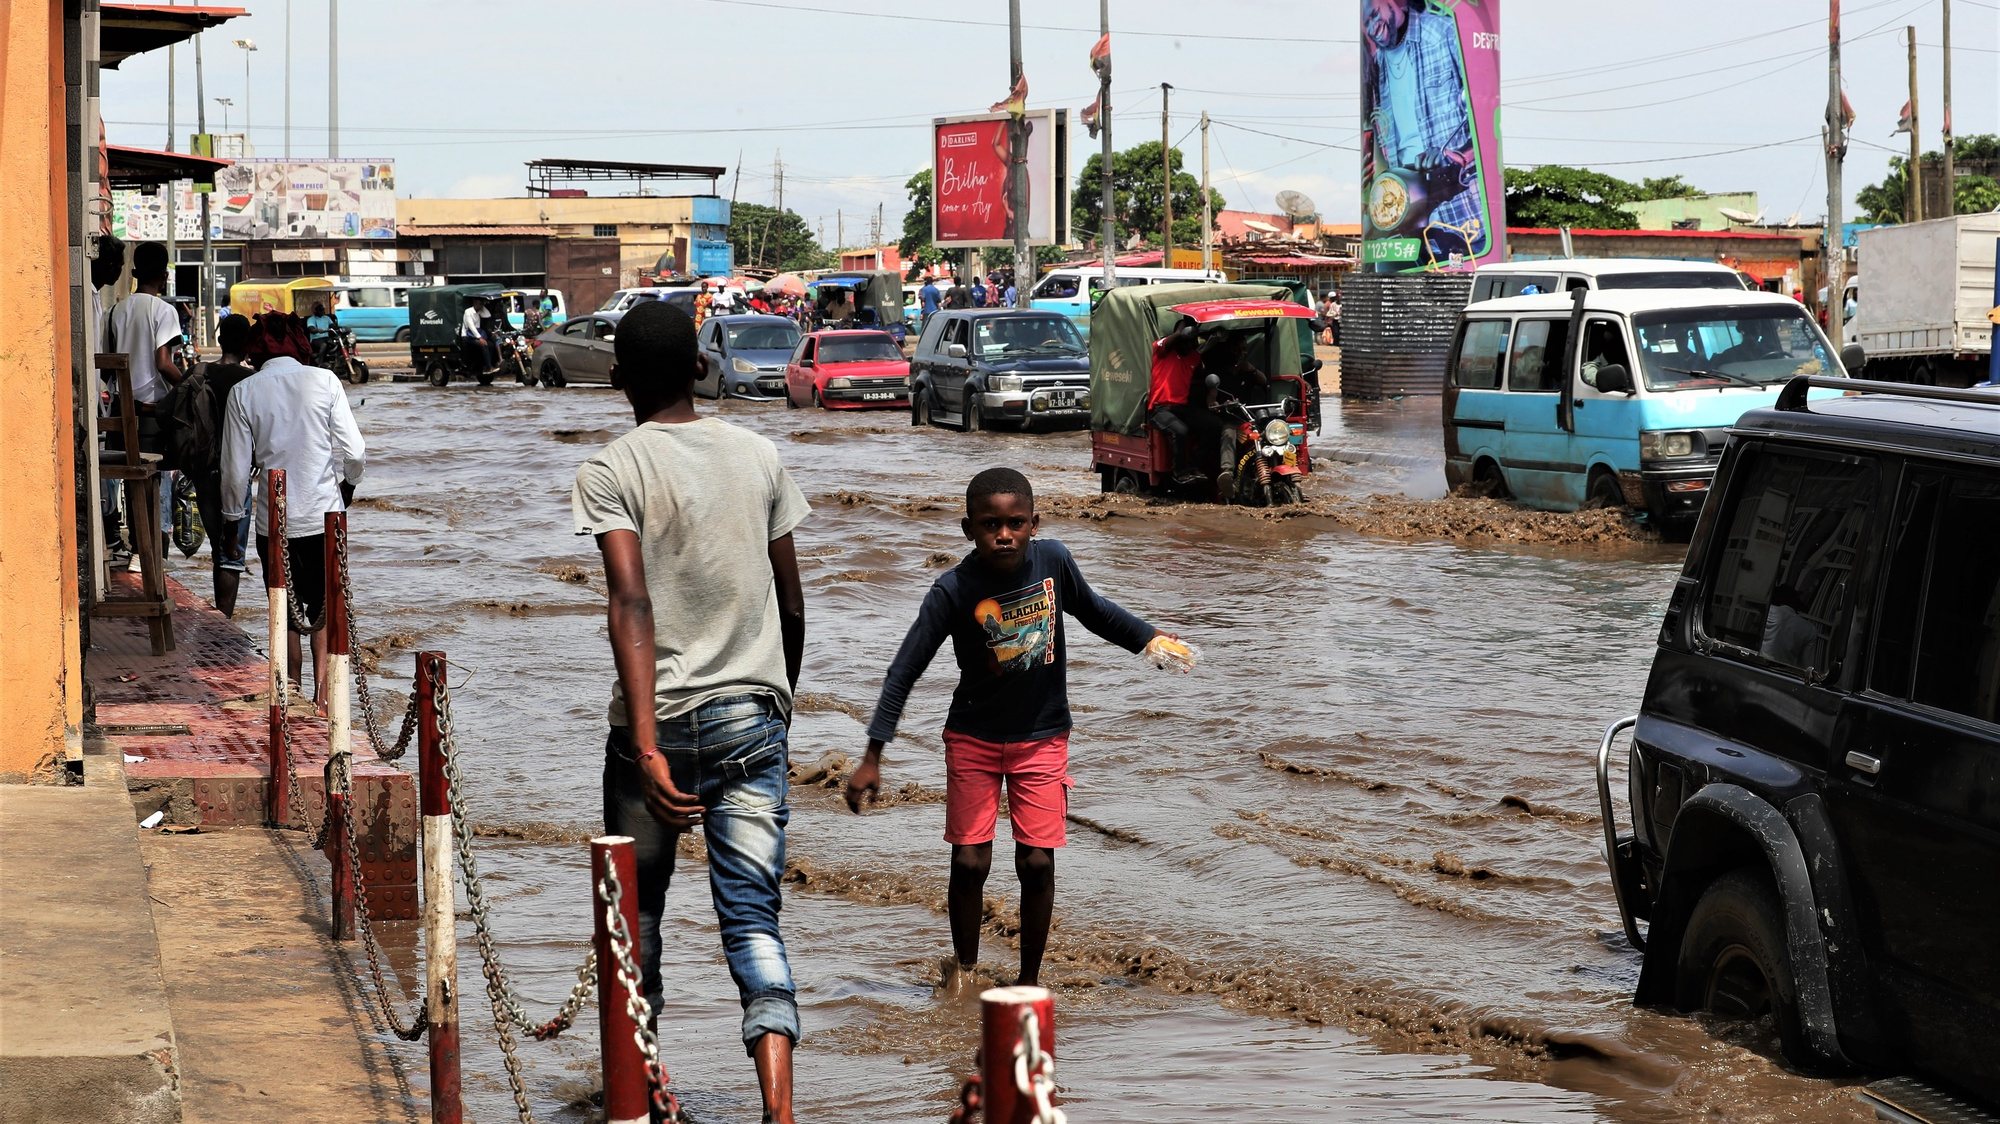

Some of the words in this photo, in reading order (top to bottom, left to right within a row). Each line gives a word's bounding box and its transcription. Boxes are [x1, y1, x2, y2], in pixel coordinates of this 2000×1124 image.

[949, 135, 976, 145] DARLING
[941, 157, 988, 195] Brilha
[1002, 601, 1047, 622] GLACIAL
[1014, 612, 1043, 628] Freestyle
